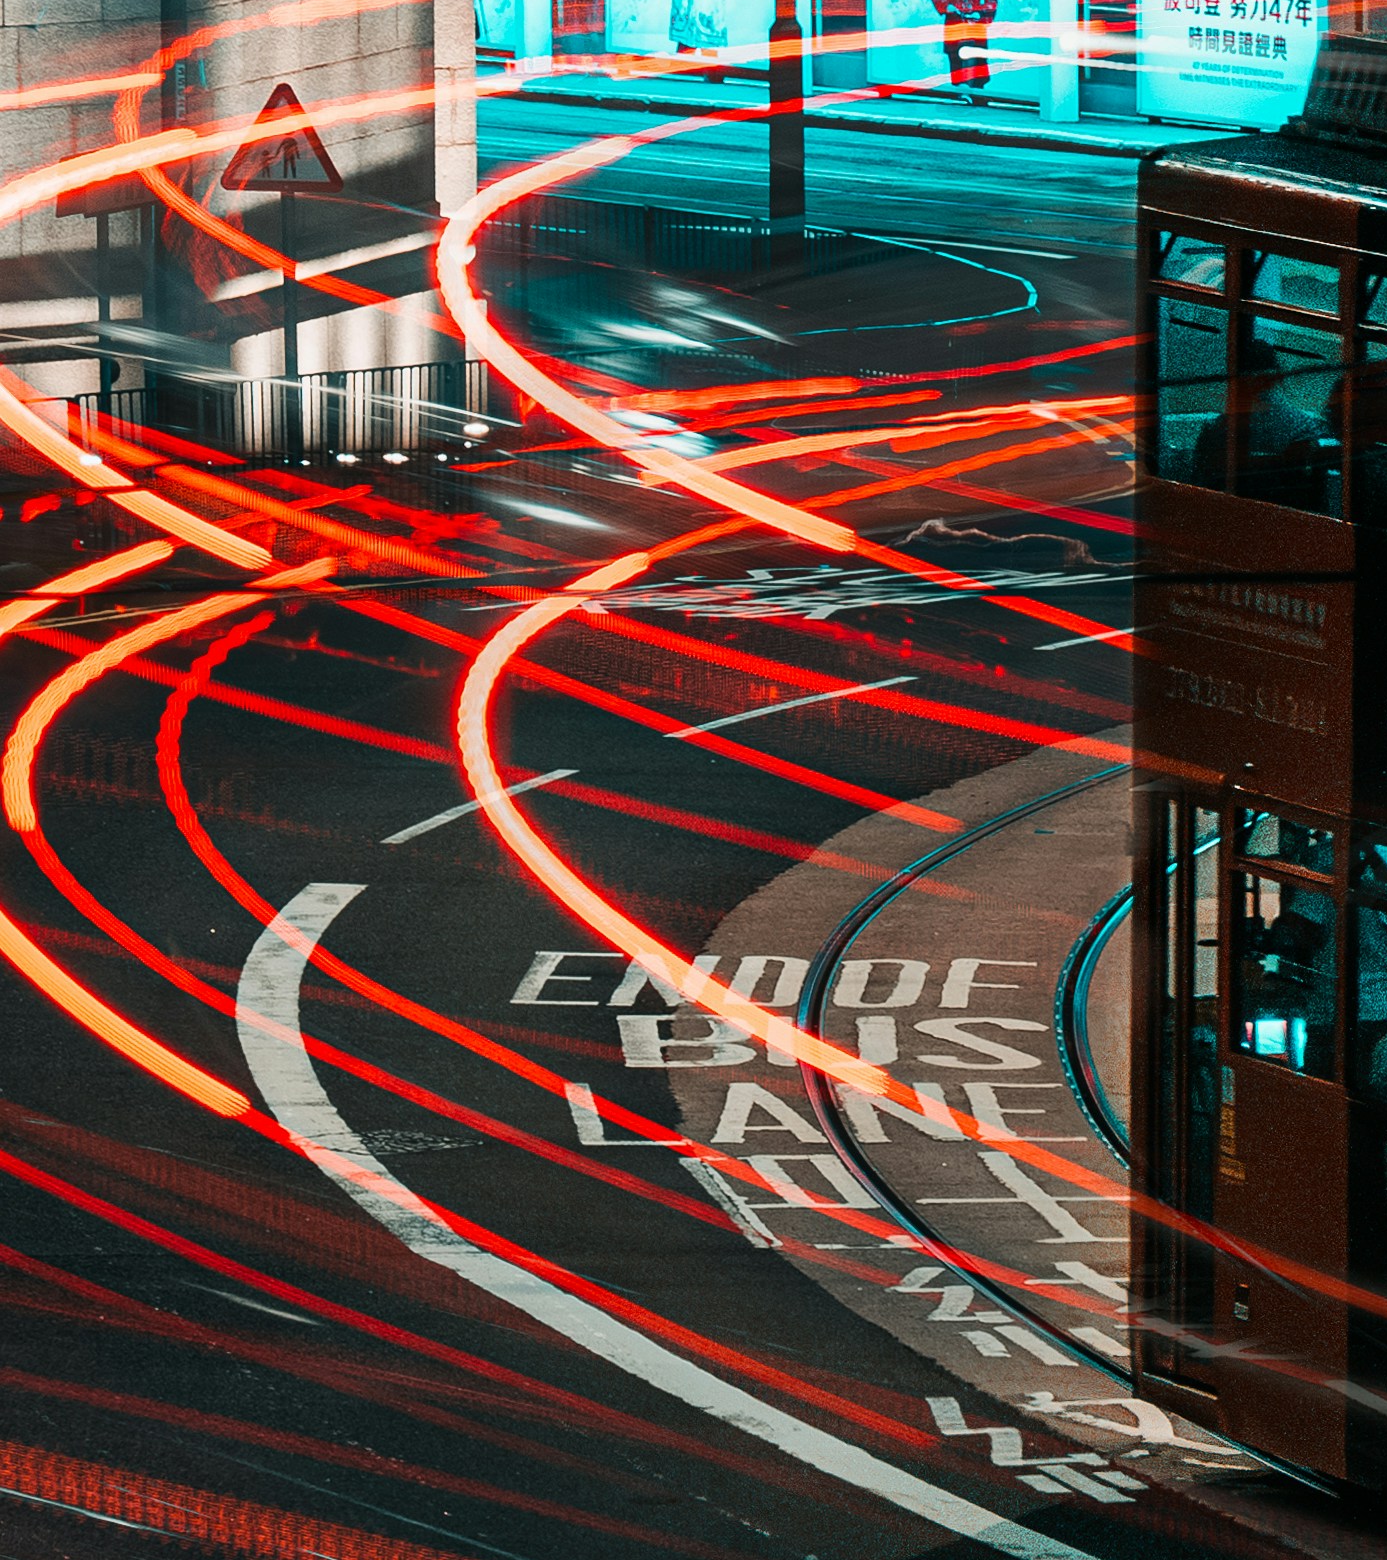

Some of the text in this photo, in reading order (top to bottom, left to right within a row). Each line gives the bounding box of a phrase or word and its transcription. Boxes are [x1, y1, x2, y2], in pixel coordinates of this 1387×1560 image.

[1187, 25, 1288, 62] 時間見證經典
[510, 951, 1038, 1009] END OF
[616, 1014, 1049, 1069] BUS
[565, 1082, 1088, 1145] LANE
